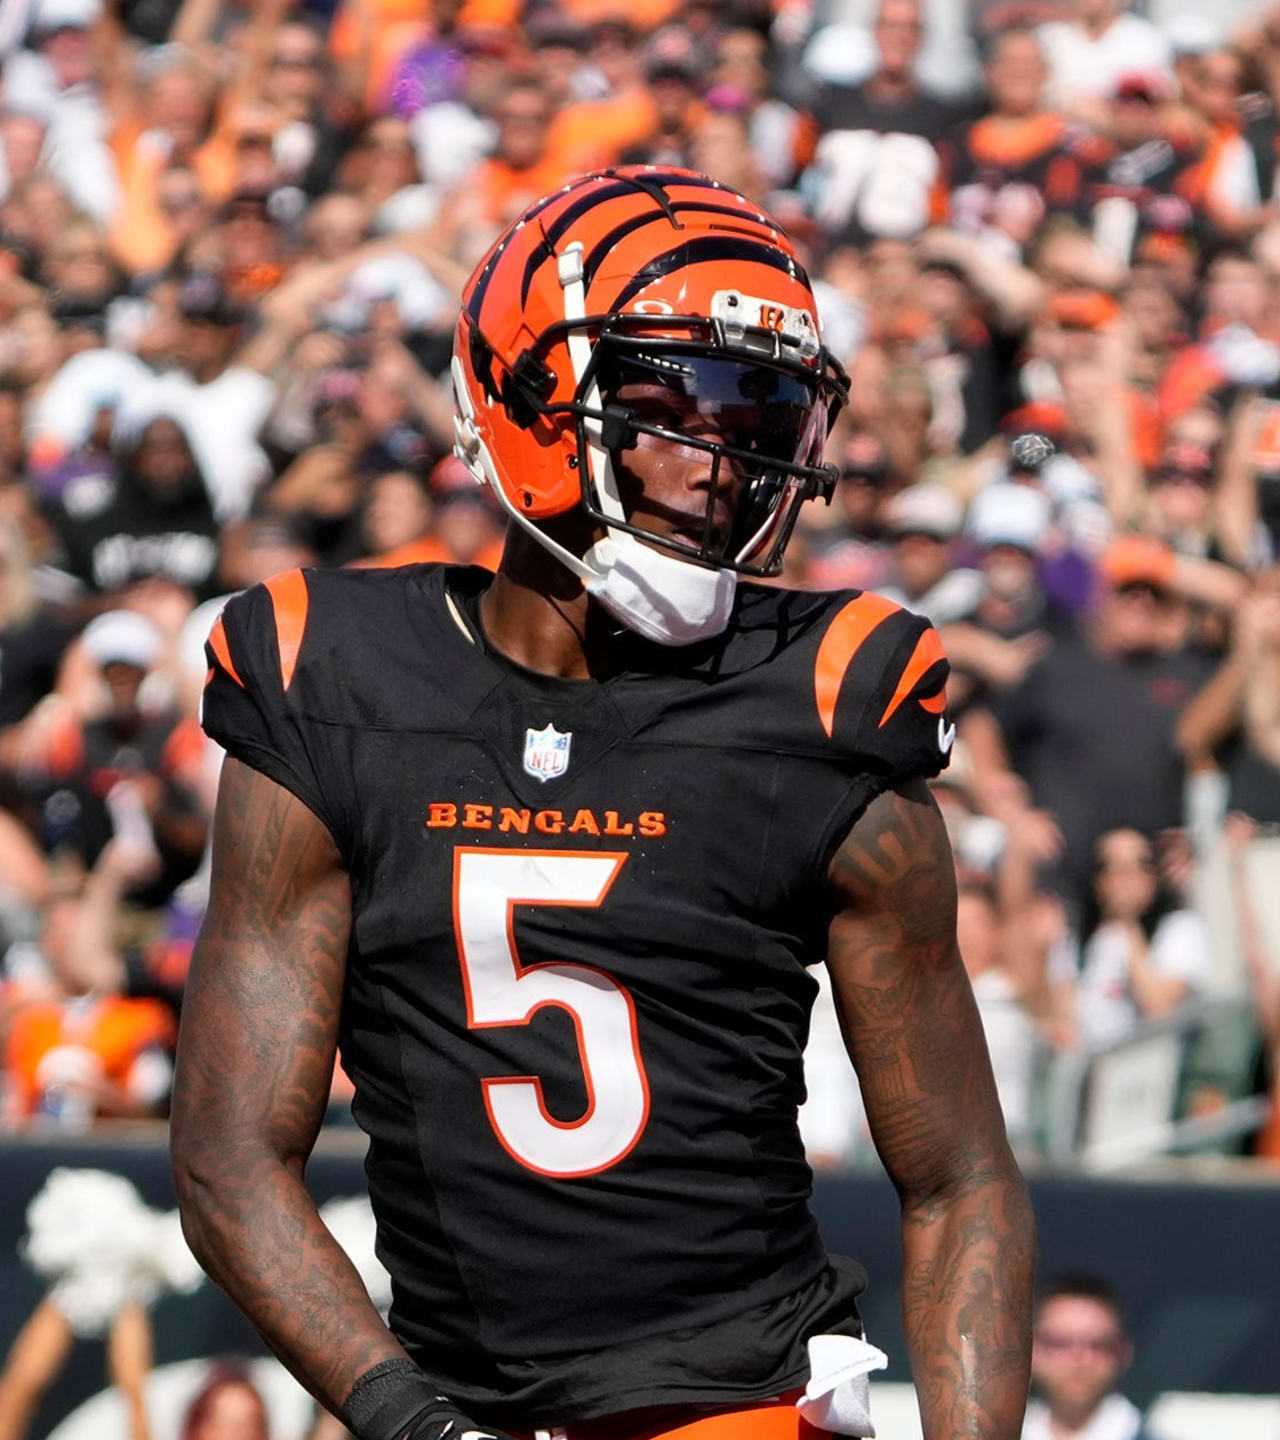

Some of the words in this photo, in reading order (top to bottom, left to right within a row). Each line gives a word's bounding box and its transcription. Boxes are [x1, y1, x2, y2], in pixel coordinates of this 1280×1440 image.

[531, 750, 562, 771] NFL
[426, 803, 667, 837] BENGALS
[452, 846, 651, 1179] 5
